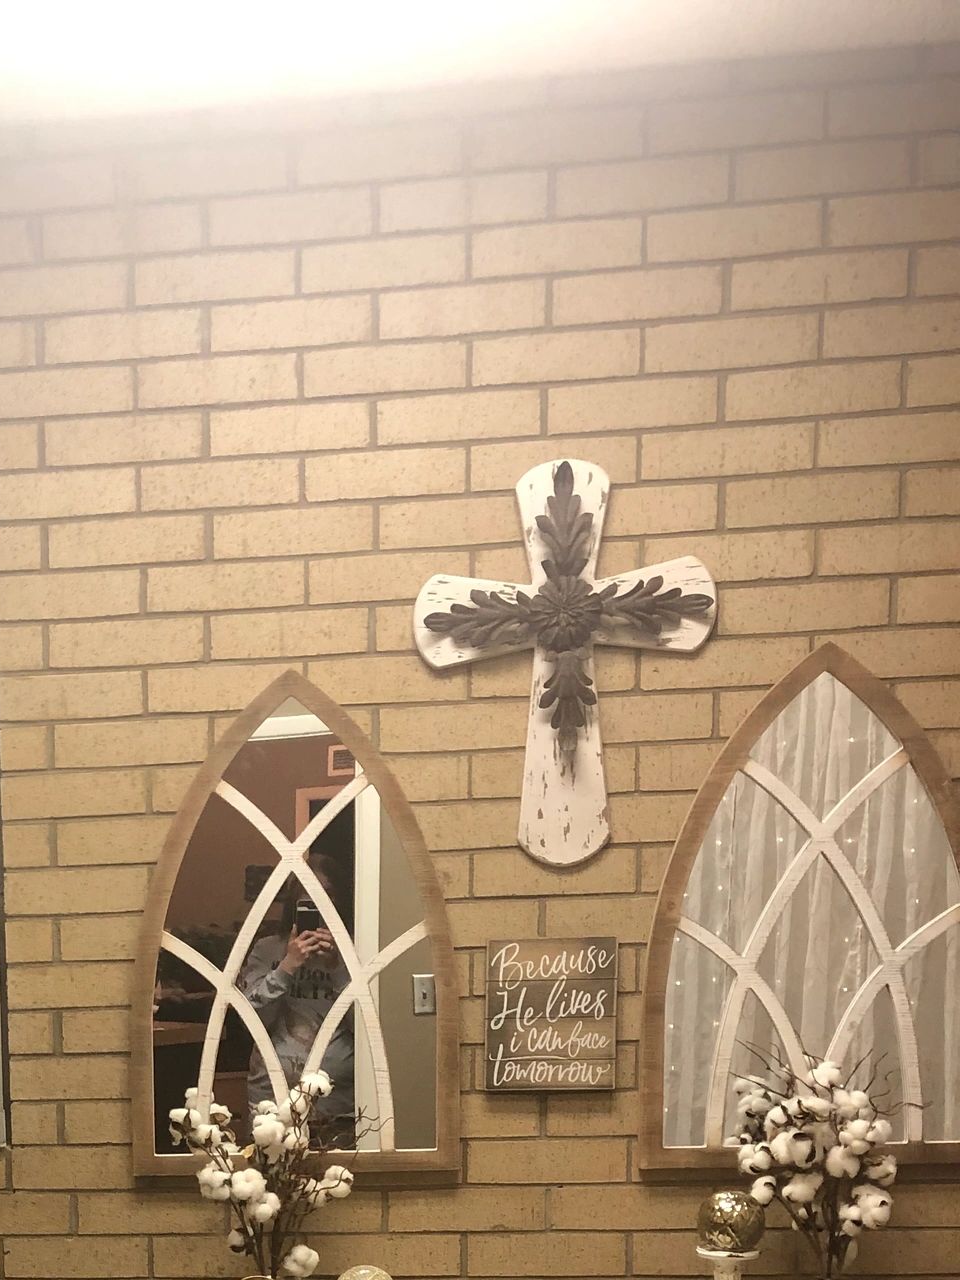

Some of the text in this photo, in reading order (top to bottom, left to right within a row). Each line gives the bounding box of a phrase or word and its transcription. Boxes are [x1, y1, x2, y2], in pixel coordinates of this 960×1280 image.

[491, 943, 615, 990] Because
[490, 975, 609, 1032] He lives
[510, 1020, 610, 1058] i can face
[489, 1043, 611, 1087] tomorrow
